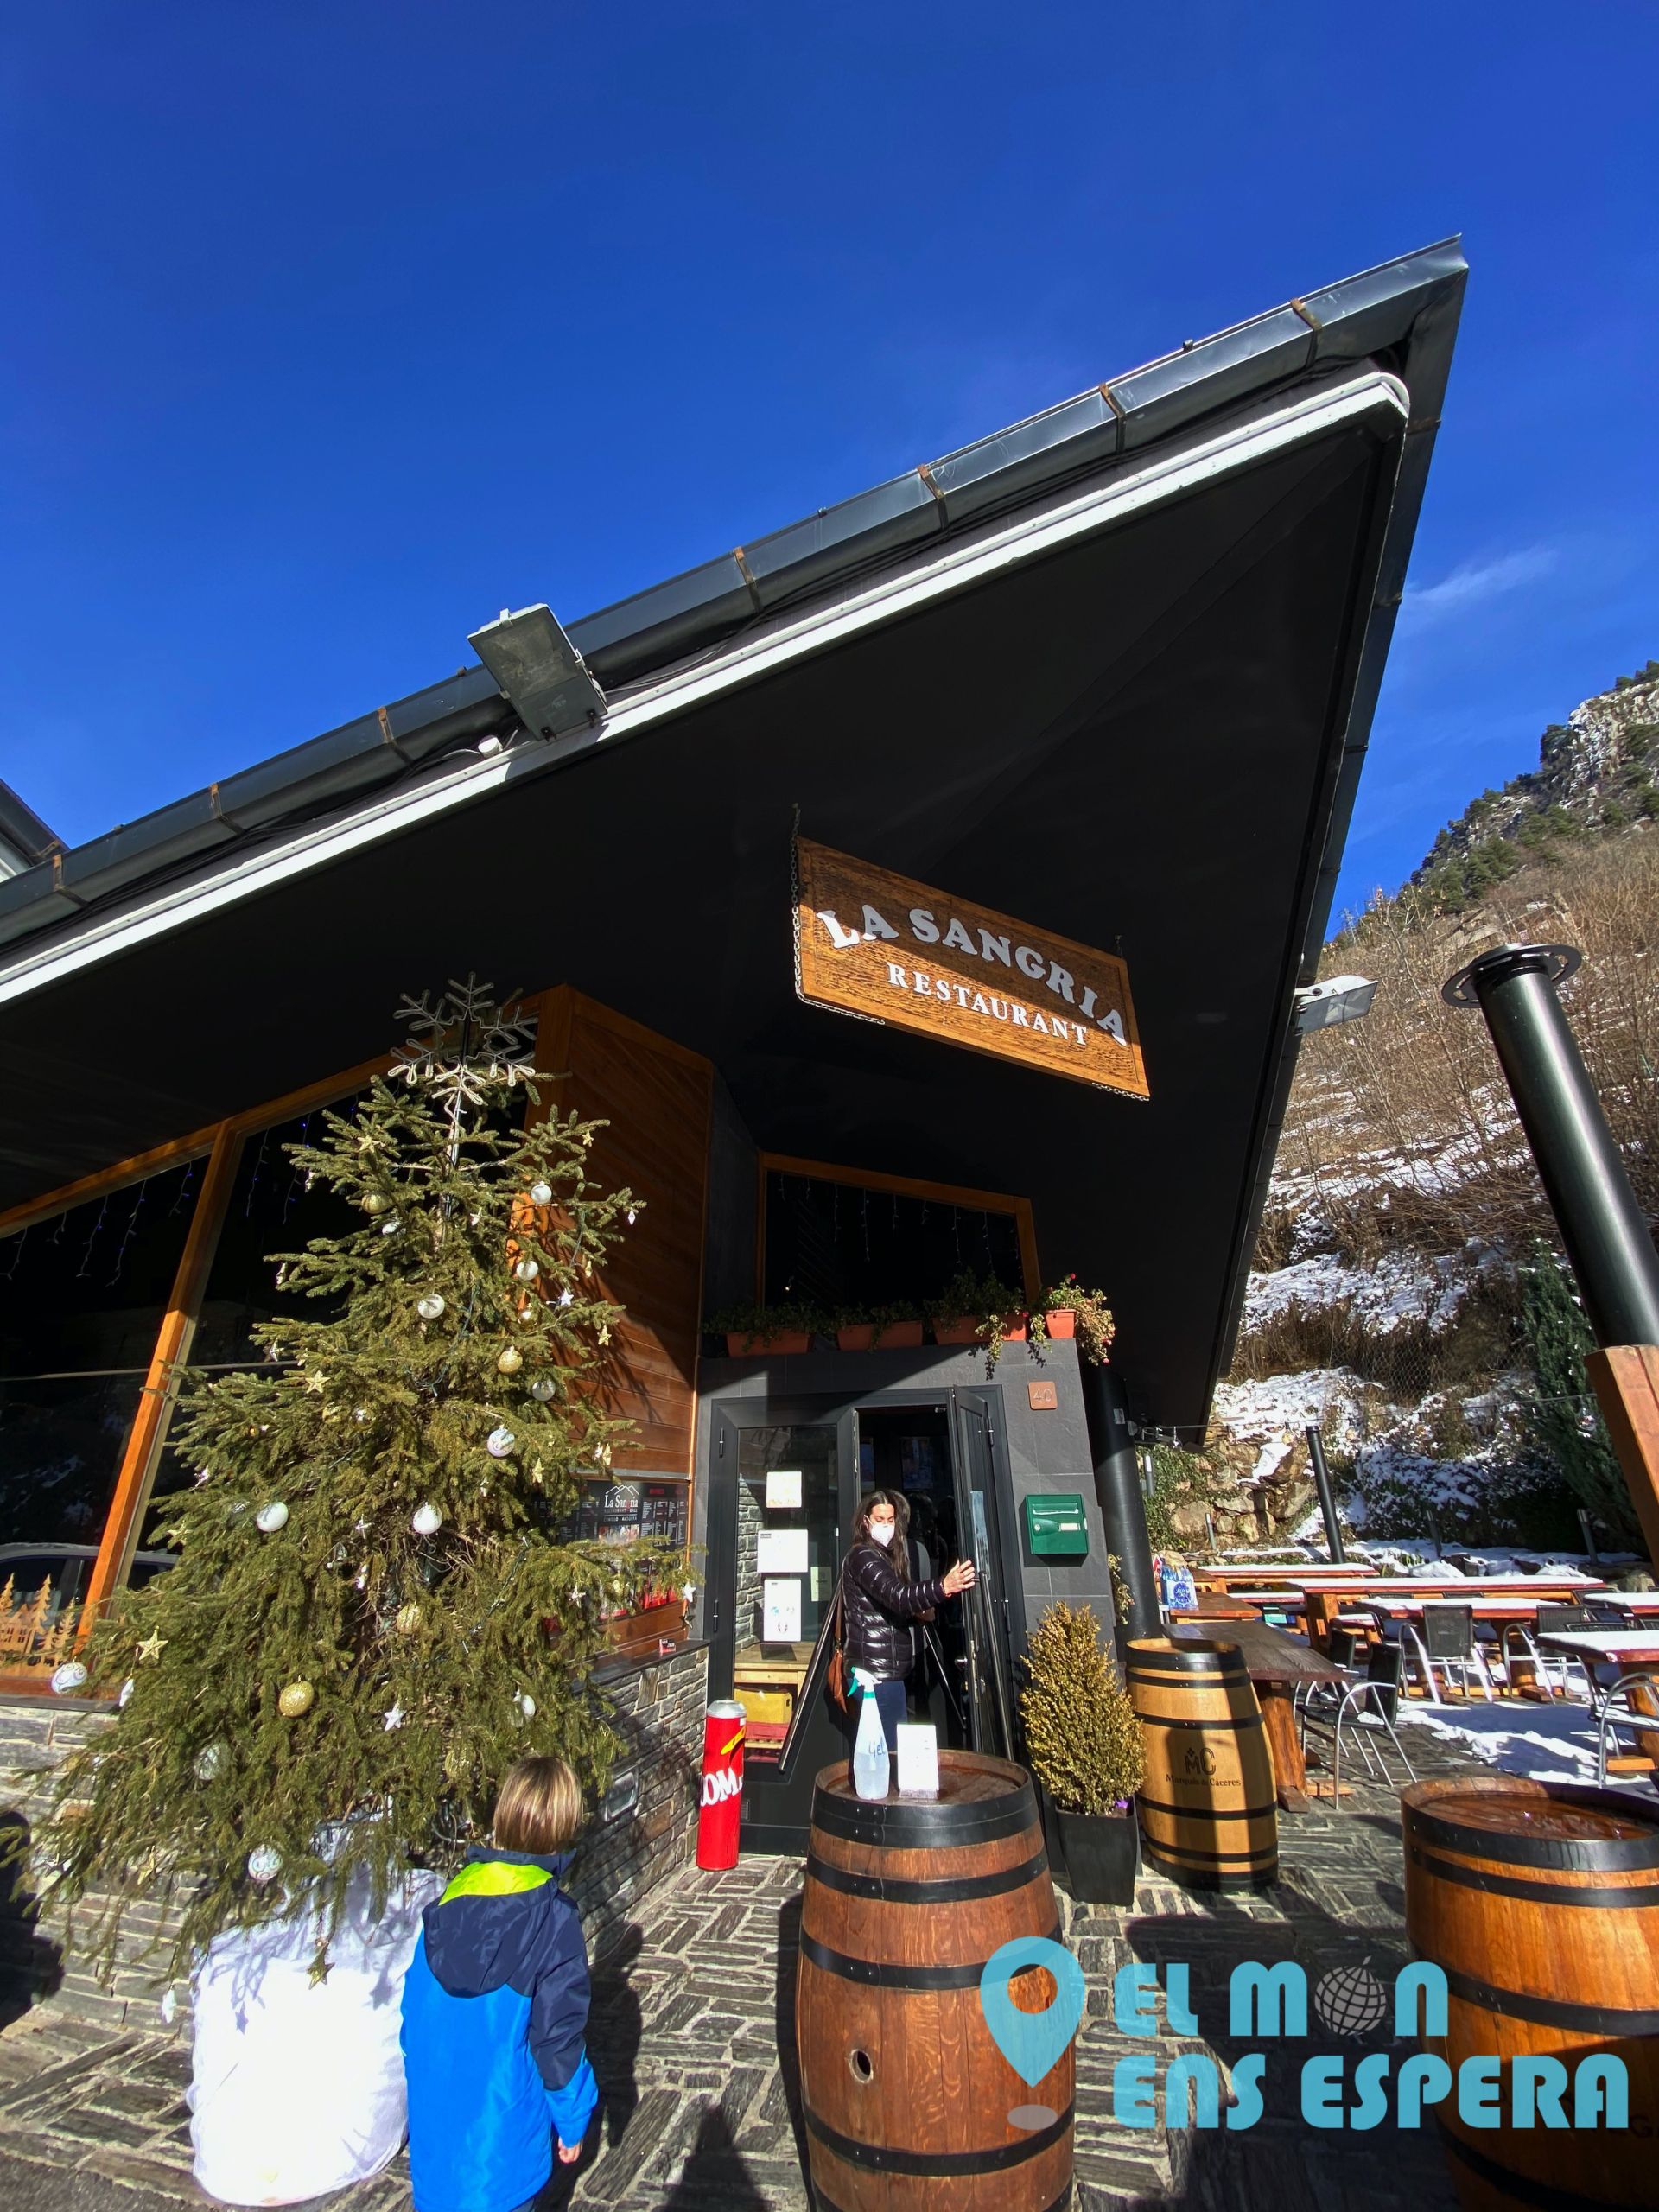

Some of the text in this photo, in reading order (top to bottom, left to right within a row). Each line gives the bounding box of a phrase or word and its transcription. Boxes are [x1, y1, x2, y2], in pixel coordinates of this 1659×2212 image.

[817, 904, 1128, 1047] LA SANGRIA
[886, 962, 1089, 1046] RESTAURANT
[1033, 1388, 1052, 1402] 40
[605, 1495, 613, 1508] La
